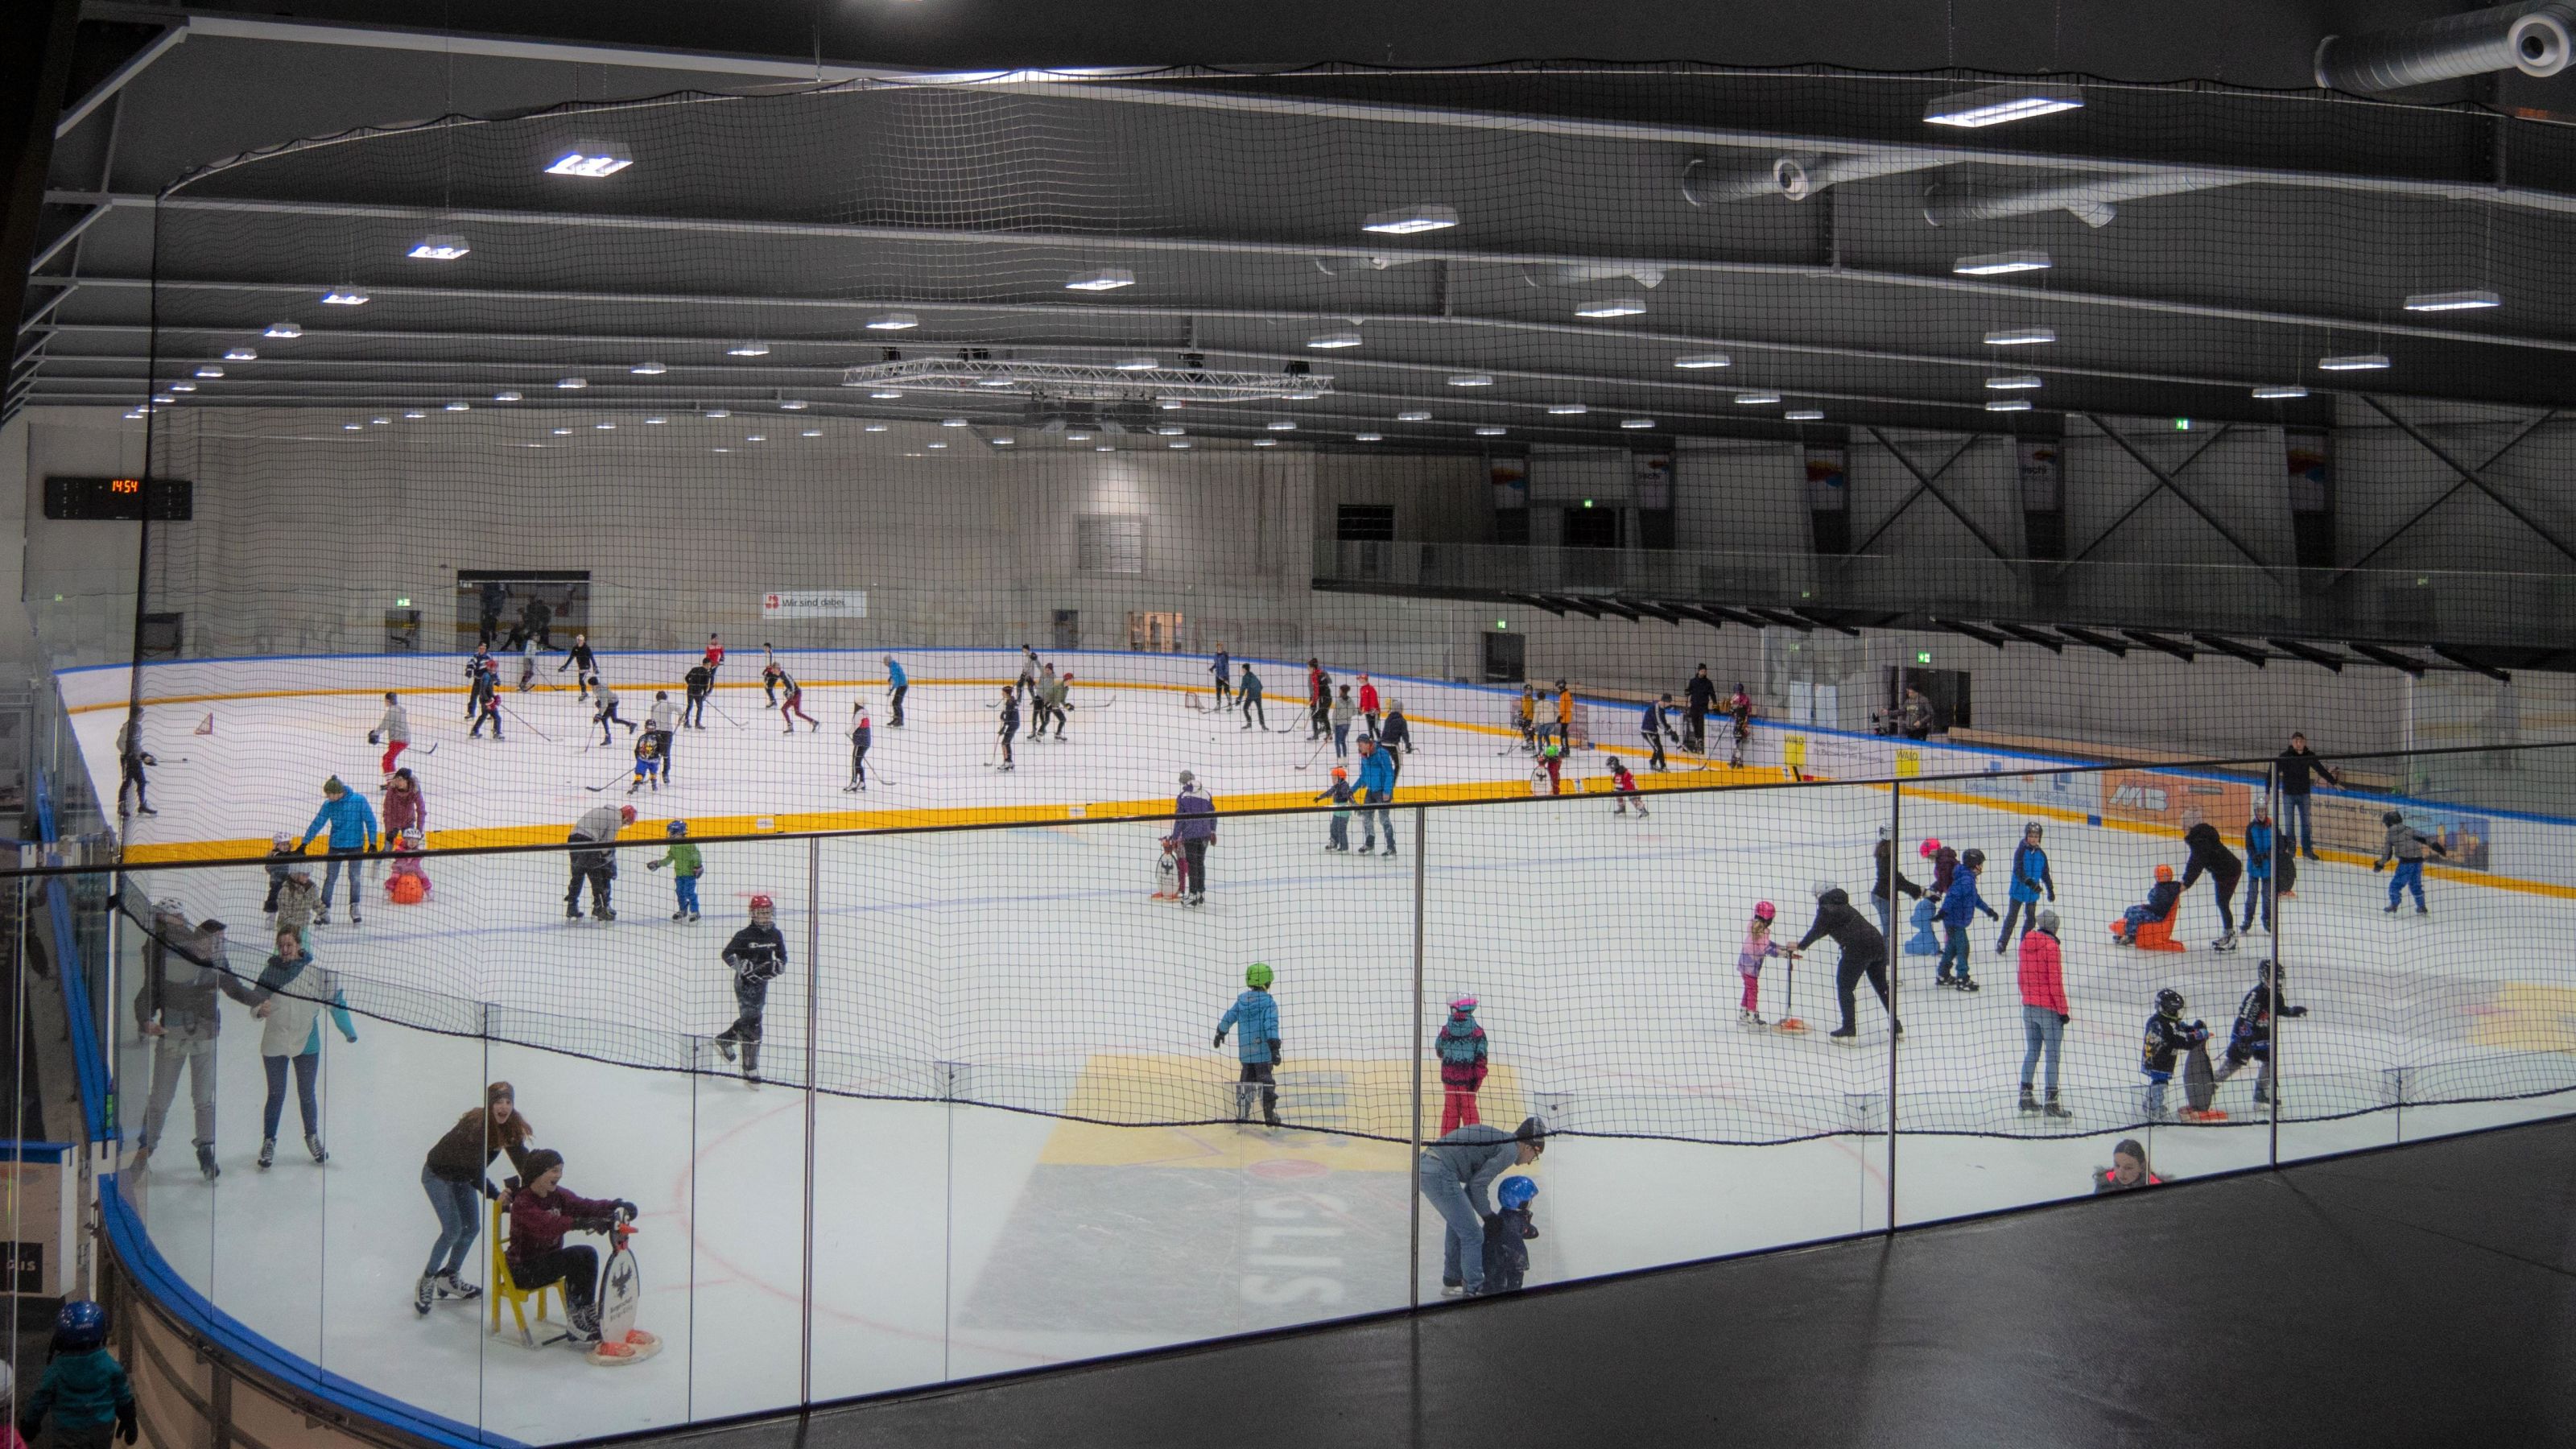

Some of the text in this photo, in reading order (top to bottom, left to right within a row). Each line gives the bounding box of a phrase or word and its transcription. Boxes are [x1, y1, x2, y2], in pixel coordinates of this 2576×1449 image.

[782, 598, 797, 607] Wir
[799, 597, 818, 607] sind
[1784, 734, 1804, 746] WALO
[1896, 749, 1918, 762] WALO
[2107, 781, 2170, 811] MB
